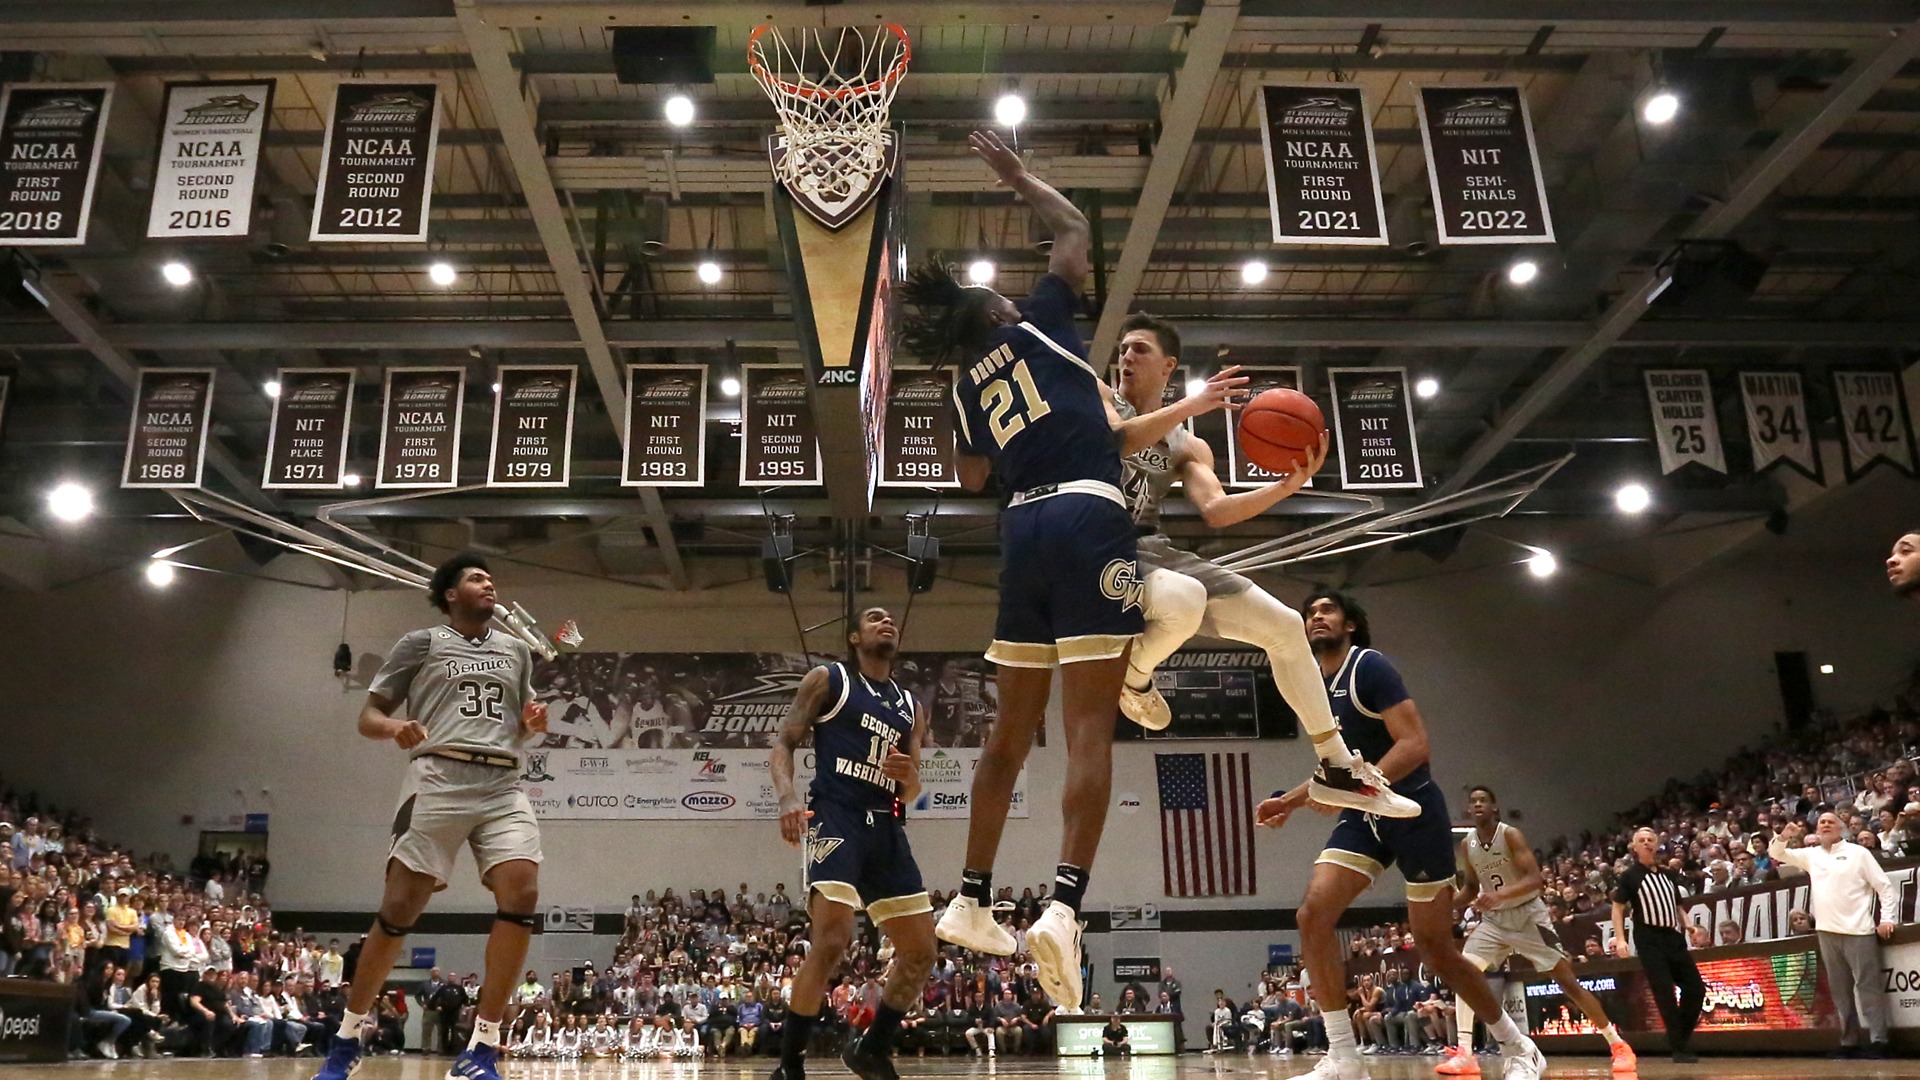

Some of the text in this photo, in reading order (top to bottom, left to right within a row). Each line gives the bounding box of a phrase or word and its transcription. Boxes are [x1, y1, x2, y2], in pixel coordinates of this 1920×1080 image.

[352, 113, 416, 122] BONNIES
[1283, 116, 1348, 125] BONNIES
[11, 143, 77, 160] NCAA
[177, 141, 243, 158] NCAA
[345, 139, 413, 155] NCAA
[1286, 141, 1354, 158] NCAA
[339, 157, 417, 166] TOURNAMENT
[1461, 149, 1502, 165] NIT
[4, 161, 80, 171] TOURNAMENT
[170, 160, 246, 169] TOURNAMENT
[1284, 159, 1360, 170] TOURNAMENT
[16, 176, 61, 189] FIRST
[177, 174, 235, 186] SECOND
[346, 173, 405, 184] SECOND
[1302, 176, 1345, 187] FIRST
[1466, 176, 1507, 187] SEMI-
[9, 190, 61, 202] ROUND
[178, 188, 230, 201] ROUND
[348, 187, 400, 198] ROUND
[1300, 189, 1352, 201] ROUND
[1463, 189, 1517, 201] FINALS
[0, 211, 63, 231] 2018
[168, 209, 232, 229] 2016
[339, 208, 402, 228] 2012
[1298, 210, 1361, 230] 2021
[1459, 210, 1529, 230] 2022
[969, 342, 1016, 386] BROWN
[818, 370, 856, 384] ANC
[1650, 374, 1704, 388] BELCHER
[1743, 374, 1800, 397] MARTIN
[1855, 375, 1894, 396] STITH
[644, 390, 690, 398] BONNIES
[1655, 390, 1704, 403] CARTER
[979, 358, 1053, 451] 21
[147, 412, 193, 425] NCAA
[398, 412, 445, 425] NCAA
[1661, 405, 1705, 419] HOLLIS
[295, 418, 325, 431] NIT
[518, 416, 549, 429] NIT
[650, 416, 681, 428] NIT
[767, 414, 797, 427] NIT
[904, 416, 934, 429] NIT
[1360, 418, 1389, 431] NIT
[1755, 404, 1802, 444] 34
[1854, 404, 1900, 443] 42
[394, 425, 448, 433] TOURNAMENT
[147, 438, 187, 447] SECOND
[292, 438, 325, 447] THIRD
[405, 438, 436, 447] FIRST
[516, 436, 547, 445] FIRST
[649, 435, 681, 445] FIRST
[761, 435, 802, 444] SECOND
[903, 436, 935, 446] FIRST
[1362, 437, 1392, 447] FIRST
[1671, 424, 1706, 454] 25
[147, 448, 184, 457] ROUND
[290, 449, 323, 458] PLACE
[401, 448, 437, 457] ROUND
[512, 447, 549, 456] ROUND
[646, 446, 683, 455] ROUND
[763, 445, 800, 455] ROUND
[901, 447, 938, 456] ROUND
[1361, 448, 1397, 458] ROUND
[139, 464, 186, 478] 1968
[284, 464, 325, 478] 1971
[395, 463, 440, 478] 1978
[506, 462, 552, 477] 1979
[640, 461, 687, 477] 1983
[758, 461, 805, 476] 1995
[896, 462, 943, 477] 1998
[1360, 463, 1403, 479] 2016
[1158, 652, 1271, 668] ONAVENTU
[445, 656, 513, 680] Bonnies
[456, 679, 506, 724] 32
[860, 713, 902, 746] GEORGE
[693, 752, 711, 761] KEL
[867, 735, 890, 769] 11
[919, 759, 961, 770] SENECA
[835, 756, 897, 794] WASHINGT
[576, 795, 619, 808] CUTCO
[688, 796, 729, 806] mazza
[933, 792, 969, 805] Stark
[1115, 965, 1151, 976] ESPN
[2, 1013, 41, 1040] pepsi
